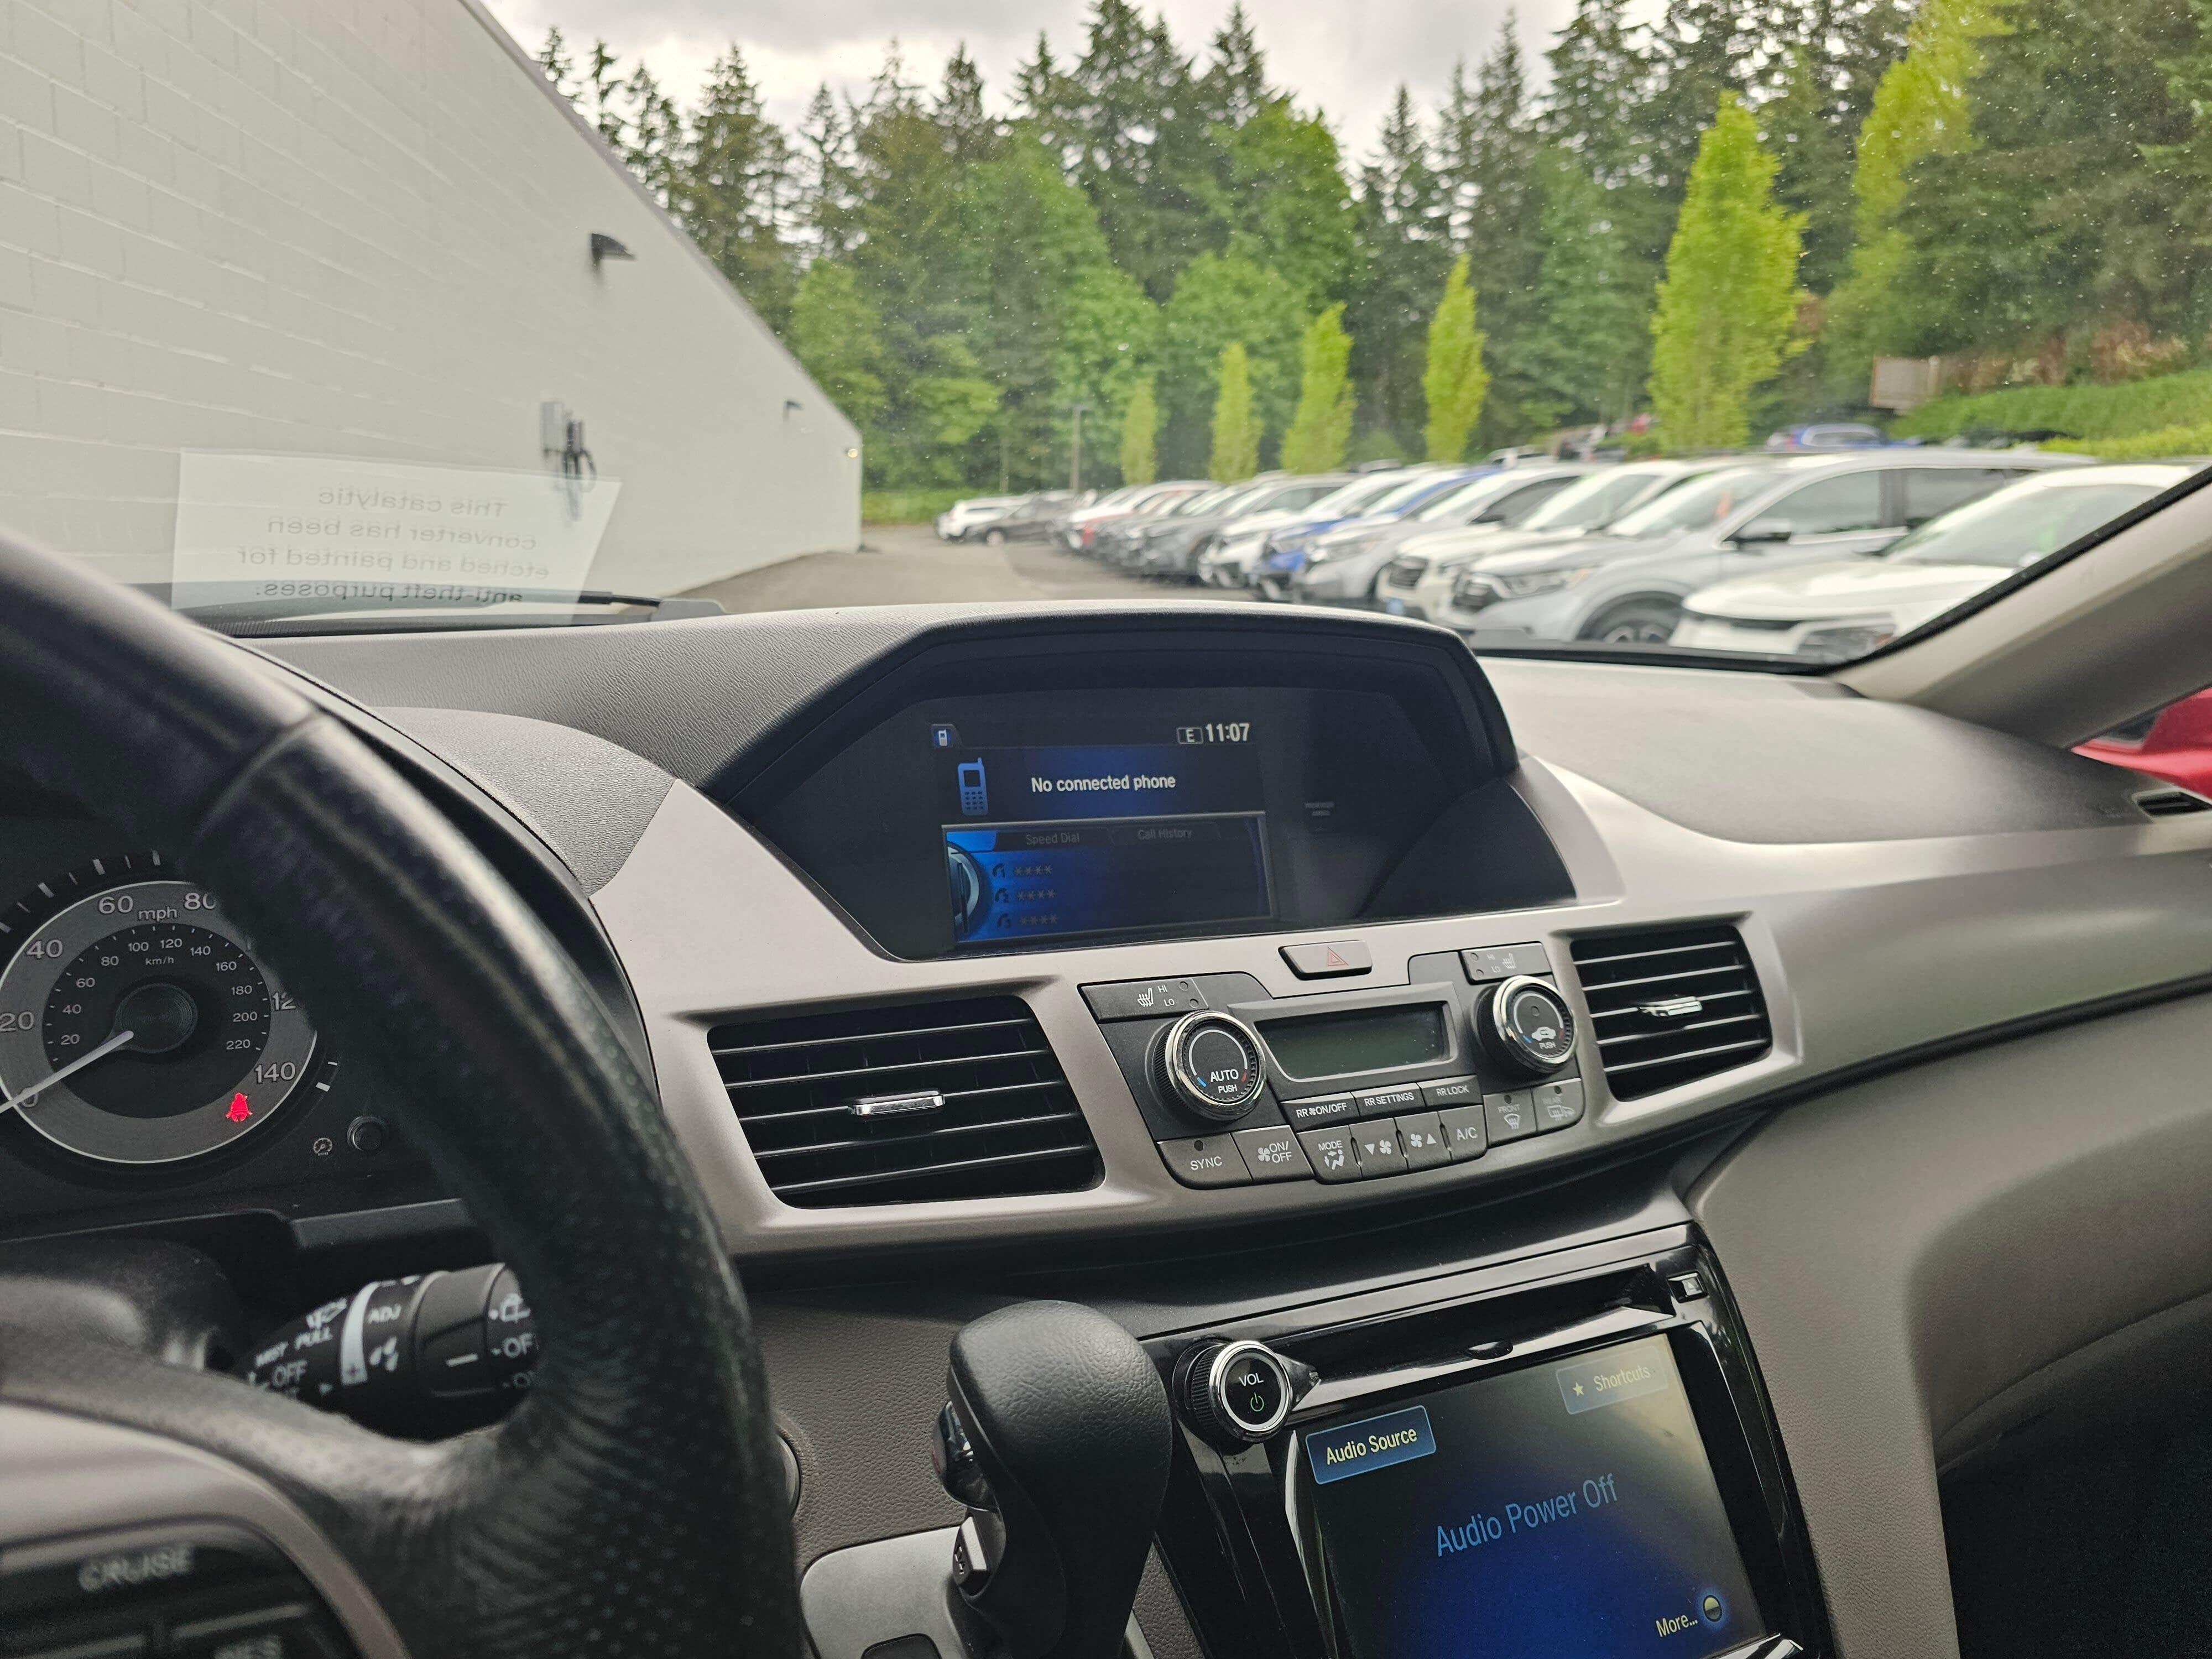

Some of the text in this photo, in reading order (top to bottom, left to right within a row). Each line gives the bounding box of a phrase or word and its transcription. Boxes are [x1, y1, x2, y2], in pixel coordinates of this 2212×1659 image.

[1205, 722, 1250, 743] 11:07
[1031, 775, 1176, 793] No connected phone
[1026, 832, 1080, 846] Speed Dial
[1138, 827, 1193, 841] Call History
[98, 895, 134, 914] 60
[138, 906, 178, 922] mph
[26, 939, 64, 959] 40
[128, 941, 149, 952] 100
[159, 938, 183, 949] 120
[190, 946, 211, 957] 140
[101, 956, 119, 967] 80
[145, 956, 175, 966] km/h
[216, 961, 237, 972] 160
[76, 977, 96, 988] 60
[1157, 984, 1168, 993] HI
[231, 984, 253, 996] 180
[1163, 998, 1176, 1007] LO
[61, 1004, 82, 1015] 40
[0, 1010, 35, 1032] 20
[232, 1011, 258, 1023] 200
[60, 1034, 81, 1045] 20
[226, 1039, 251, 1050] 220
[1538, 1041, 1557, 1050] PUSH
[254, 1062, 296, 1083] 140
[1209, 1068, 1239, 1083] AUTO
[1217, 1084, 1238, 1094] PUSH
[1376, 1092, 1415, 1105] SETTINGS
[1296, 1102, 1348, 1119] RR ON/OFF
[1497, 1104, 1521, 1114] FRONT
[1456, 1127, 1479, 1141] A/C
[1269, 1141, 1289, 1153] ON/
[1318, 1140, 1343, 1151] MODE
[1190, 1156, 1223, 1171] SYNC
[1271, 1151, 1292, 1164] OFF
[502, 1333, 540, 1359] OF
[1238, 1372, 1264, 1387] VOL
[1593, 1364, 1652, 1392] Shortcuts
[1327, 1428, 1418, 1465] Audio Source
[1437, 1472, 1618, 1558] Audio Power Off
[1655, 1614, 1699, 1637] More...
